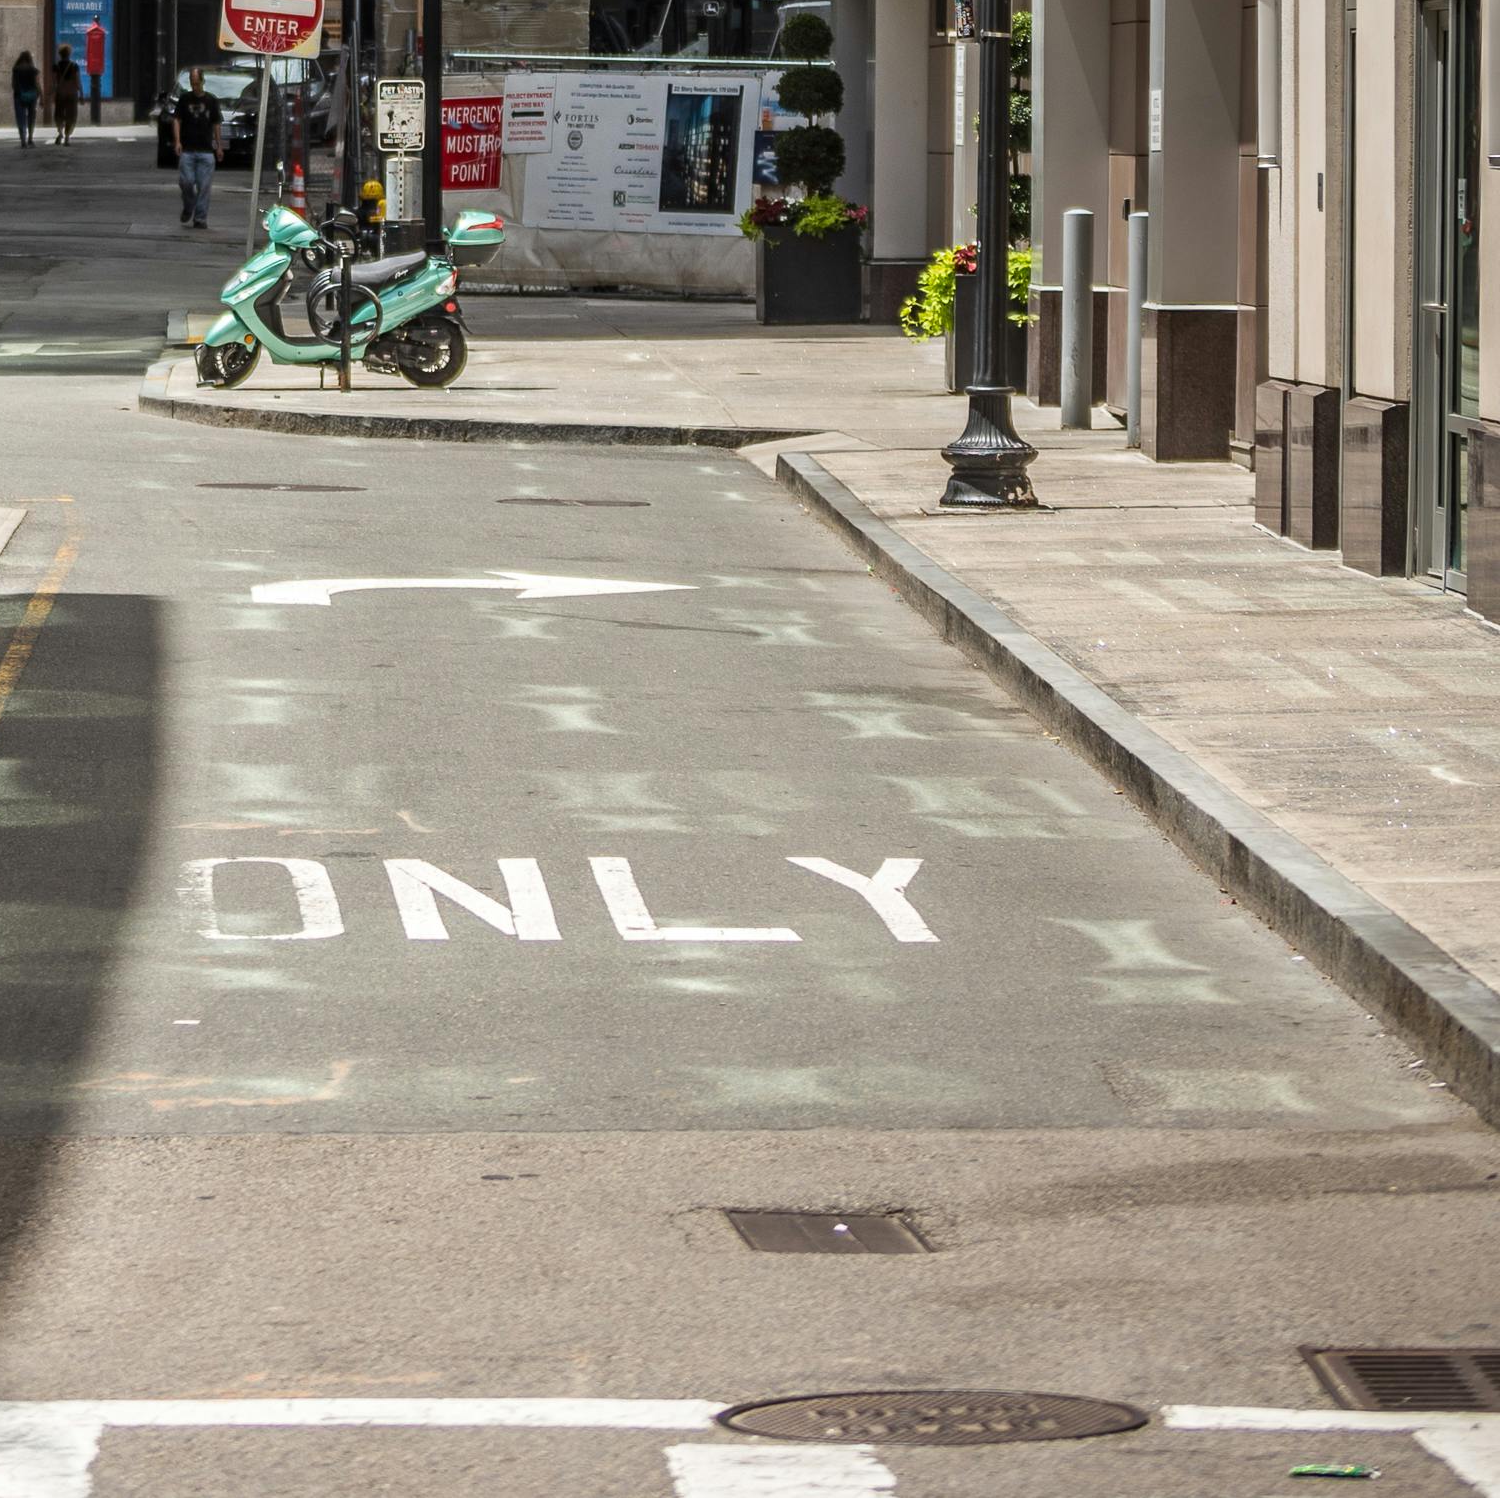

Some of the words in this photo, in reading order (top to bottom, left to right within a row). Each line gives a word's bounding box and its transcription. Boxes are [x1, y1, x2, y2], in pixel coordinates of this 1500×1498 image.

[66, 2, 102, 11] AVAILABLE
[243, 16, 299, 36] ENTER
[441, 105, 503, 125] EMERGENCY
[565, 114, 599, 123] FORTIS
[451, 164, 487, 182] POINT
[175, 856, 941, 942] ONLY
